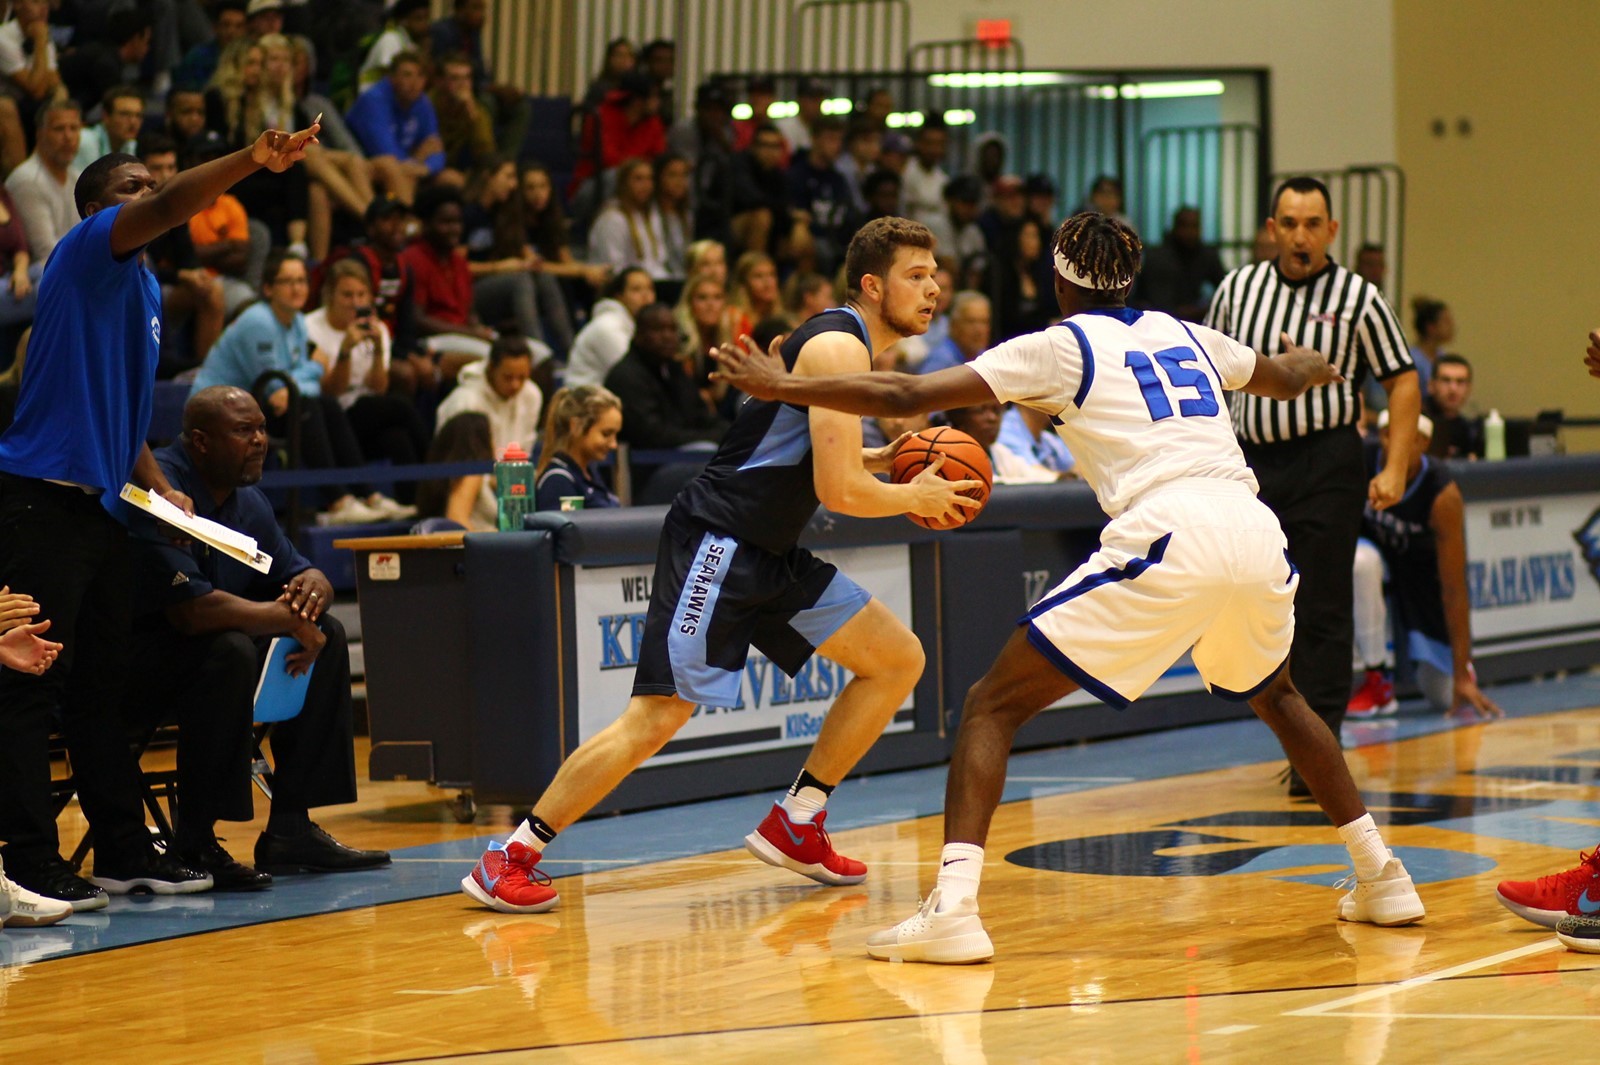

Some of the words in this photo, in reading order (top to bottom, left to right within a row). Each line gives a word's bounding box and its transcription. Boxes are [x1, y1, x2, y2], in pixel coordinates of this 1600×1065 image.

[1124, 346, 1219, 422] 15
[621, 576, 655, 602] WEL
[680, 543, 725, 636] SEAHAWKS
[691, 653, 848, 716] VERSI
[786, 711, 828, 740] KUSea
